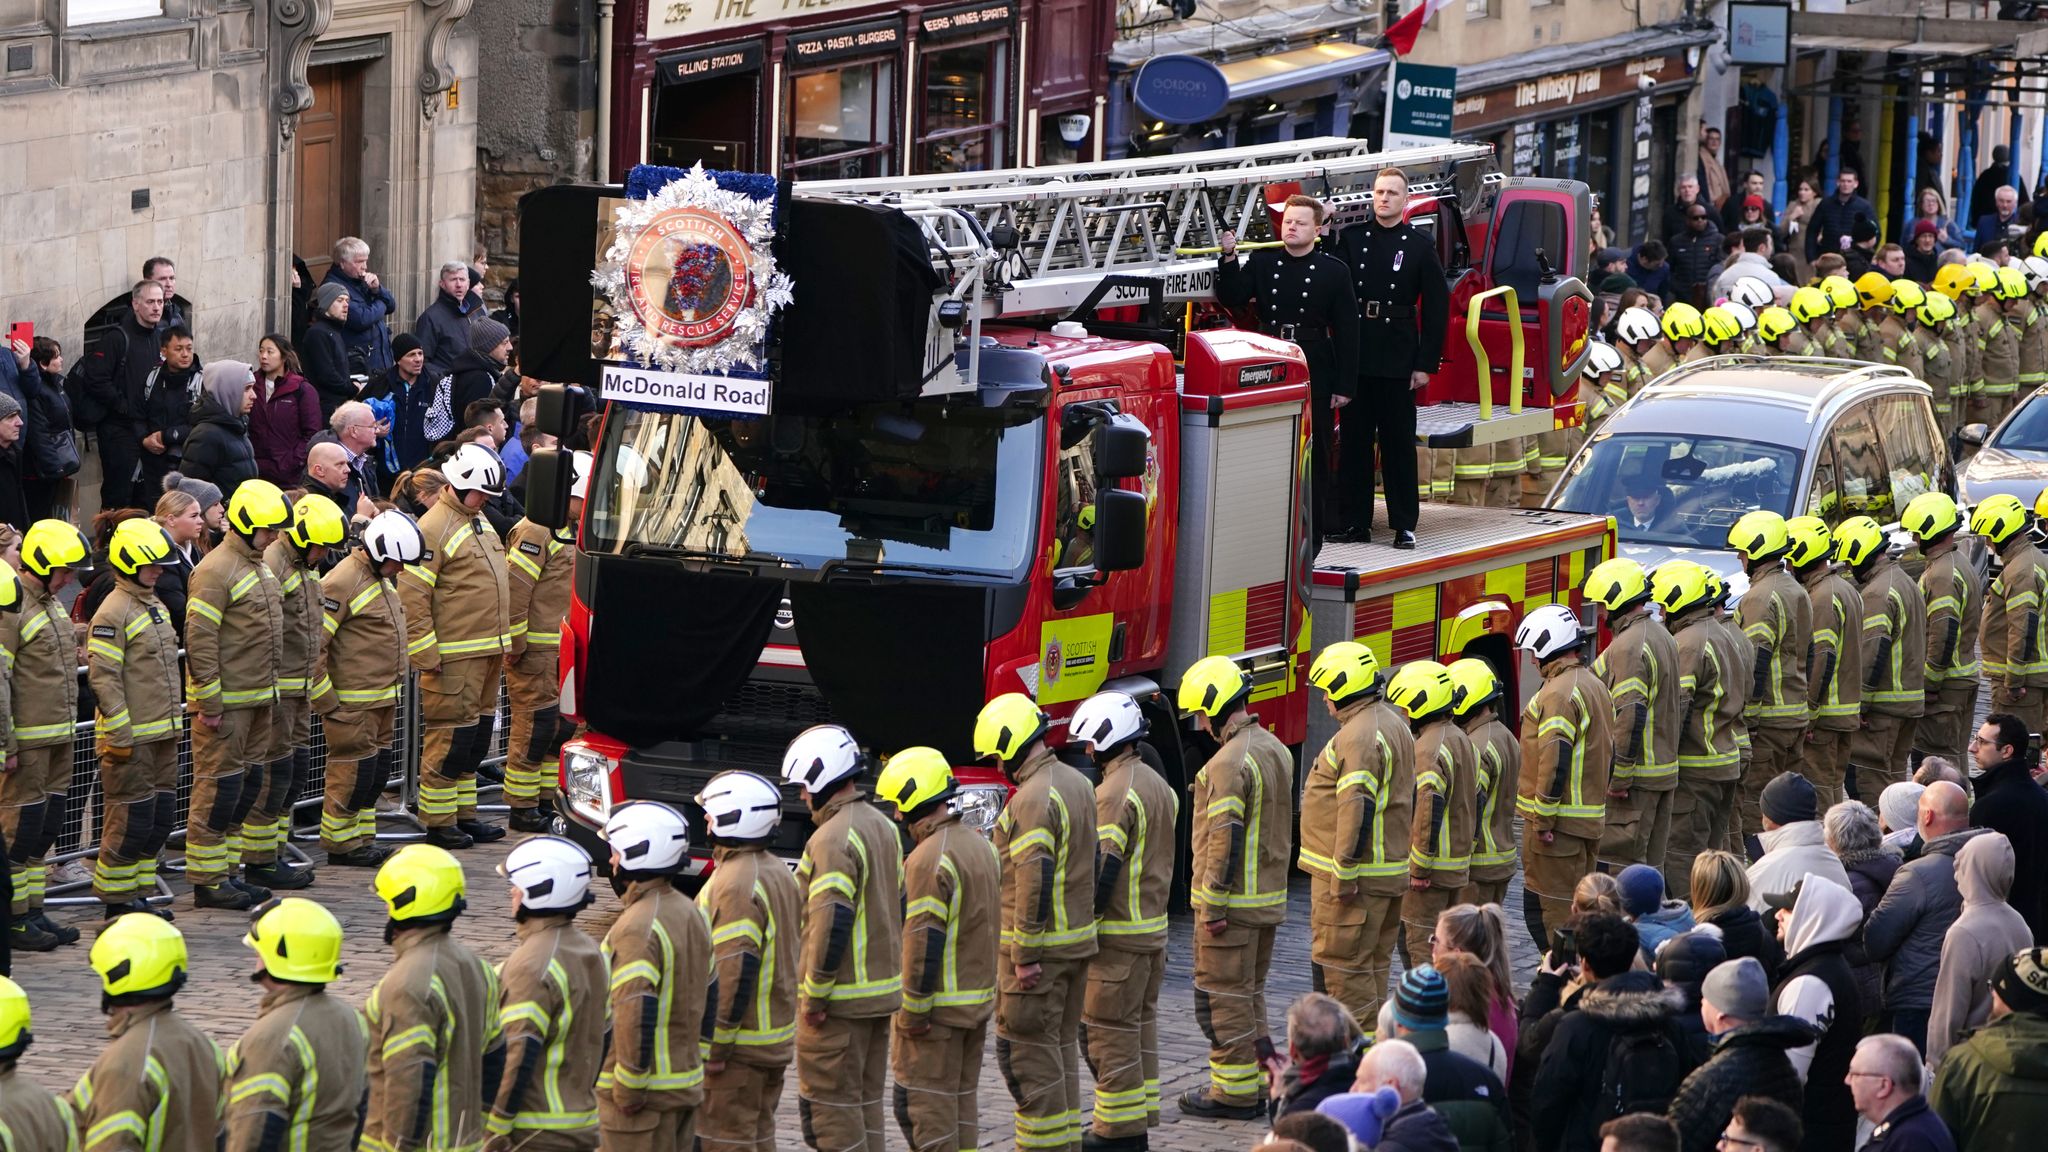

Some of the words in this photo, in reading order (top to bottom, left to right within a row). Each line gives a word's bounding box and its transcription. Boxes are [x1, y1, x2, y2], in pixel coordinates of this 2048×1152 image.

[953, 9, 979, 27] WINES
[981, 6, 1009, 22] SPIRITS
[797, 40, 824, 55] PIZZA
[827, 35, 854, 51] PASTA
[858, 29, 896, 46] BURGERS
[678, 59, 709, 76] FILLING
[711, 52, 743, 69] STATION
[1413, 86, 1453, 99] RETTIE
[1537, 74, 1577, 104] Whisky
[656, 218, 725, 241] SCOTTISH
[1166, 273, 1187, 294] FIRE
[1189, 271, 1212, 292] AND
[631, 262, 643, 293] FIRE
[638, 297, 659, 325] AND
[660, 320, 713, 336] RESCUE
[715, 271, 745, 326] SERVICE
[604, 373, 706, 401] McDonald
[714, 384, 766, 406] Road
[1066, 640, 1097, 657] SCOTTISH
